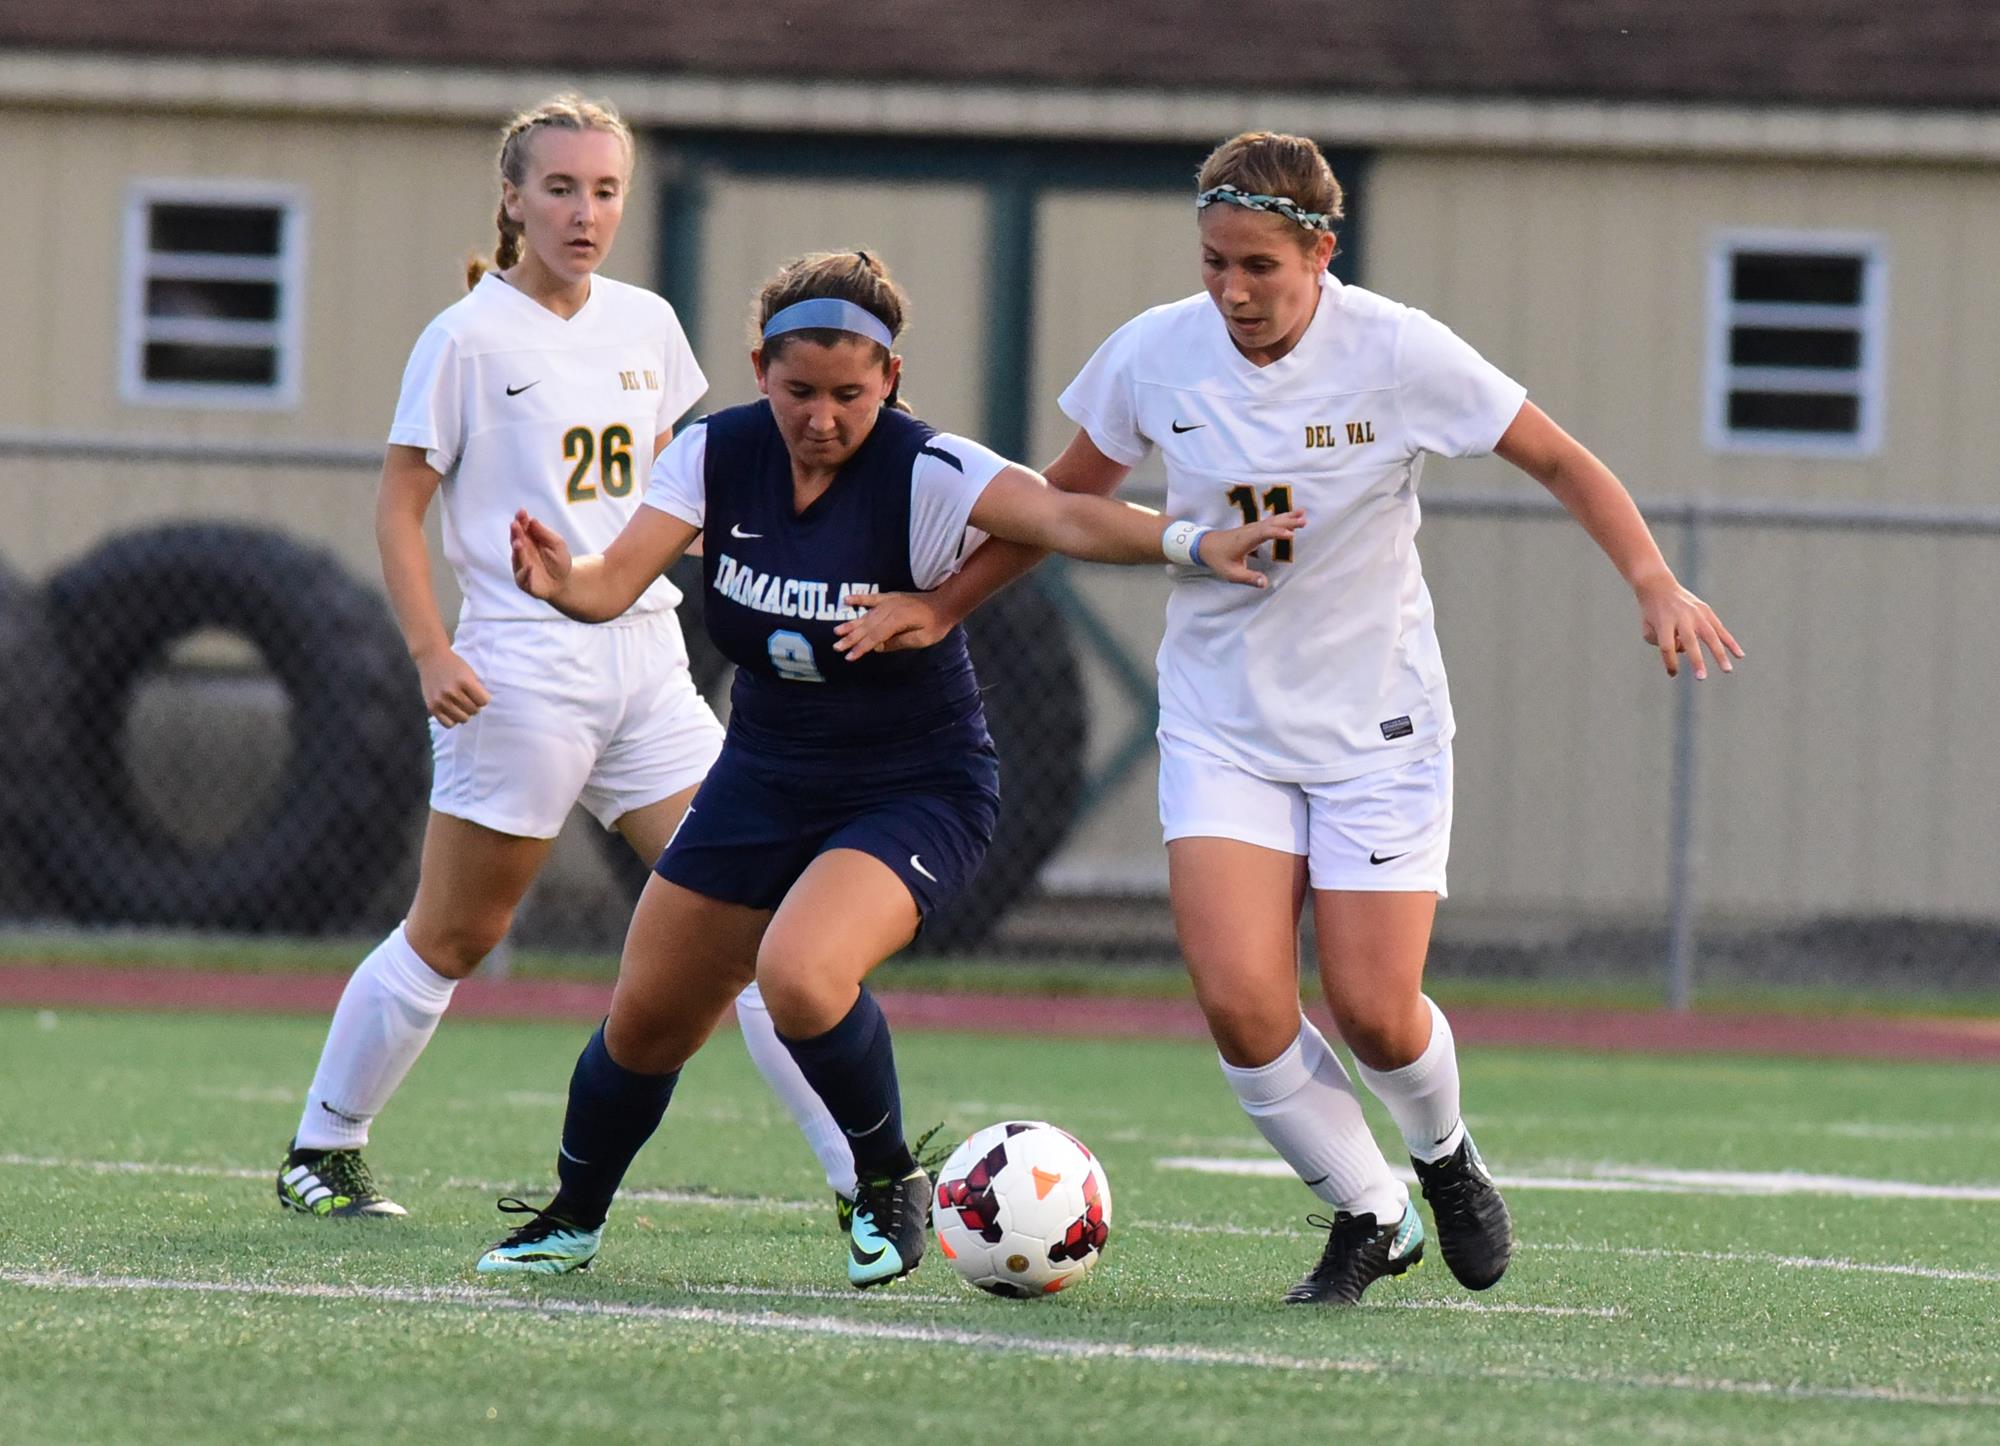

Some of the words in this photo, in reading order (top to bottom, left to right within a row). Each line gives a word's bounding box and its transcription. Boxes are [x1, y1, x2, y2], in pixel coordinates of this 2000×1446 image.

[619, 370, 640, 391] DEL
[1305, 424, 1335, 448] DEL
[1345, 420, 1375, 444] VAL
[561, 421, 635, 505] 26
[1225, 482, 1294, 563] 11
